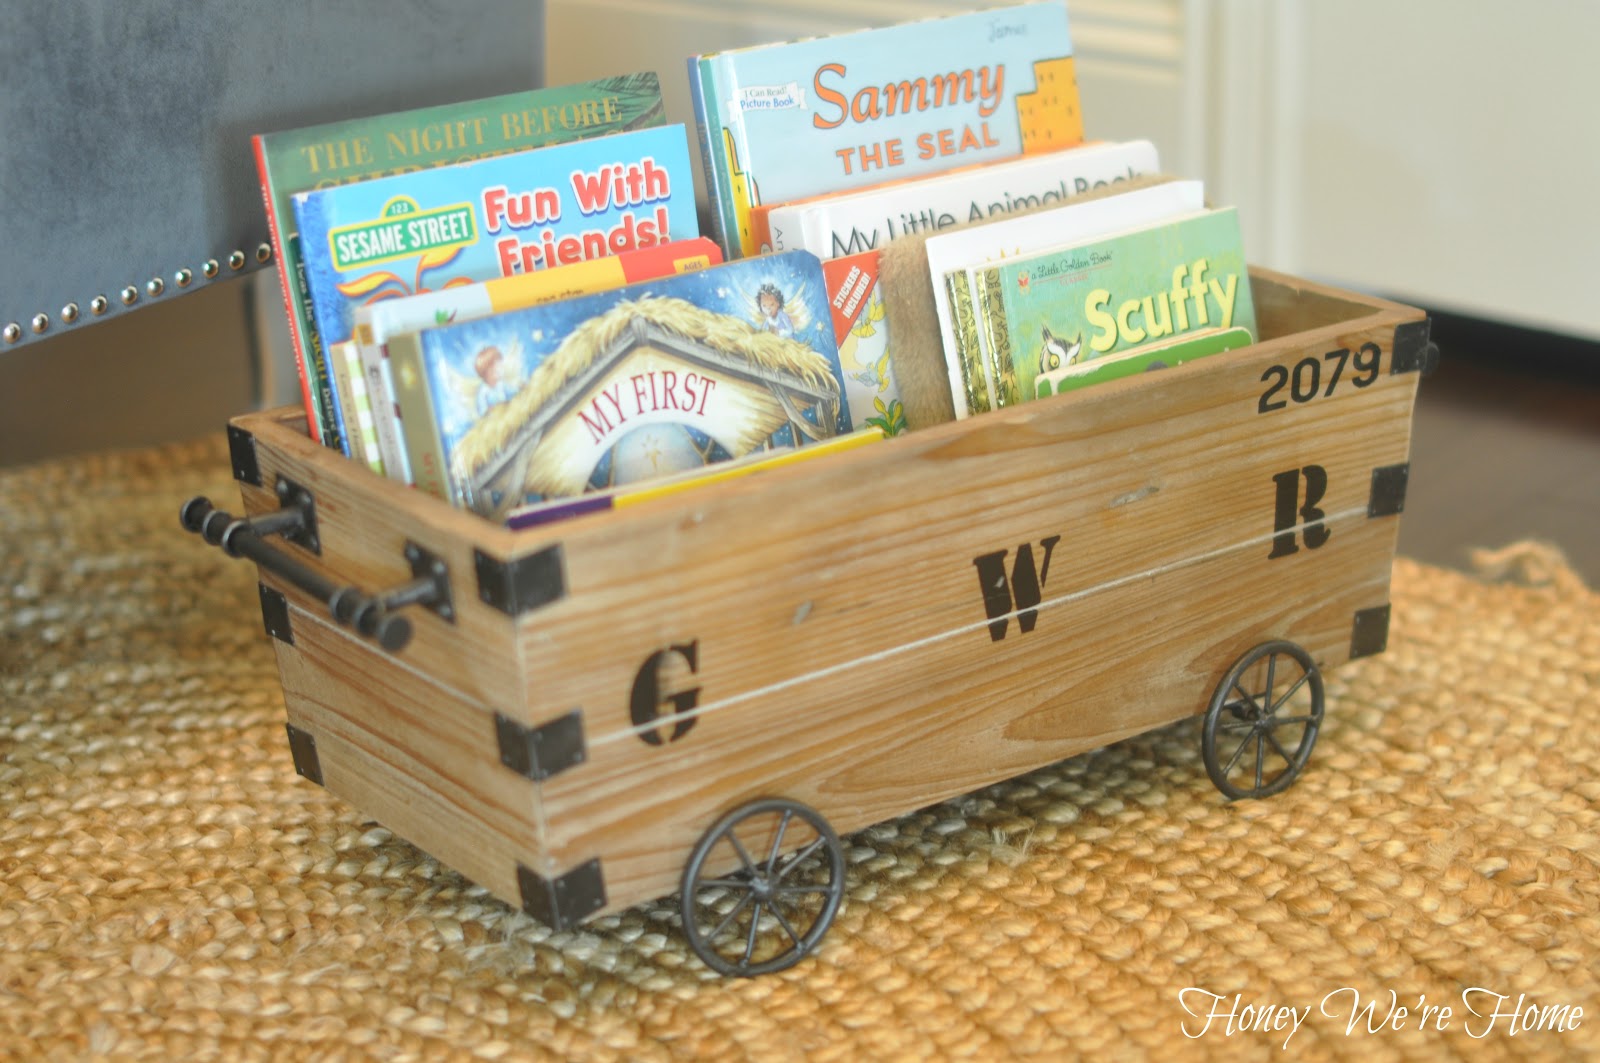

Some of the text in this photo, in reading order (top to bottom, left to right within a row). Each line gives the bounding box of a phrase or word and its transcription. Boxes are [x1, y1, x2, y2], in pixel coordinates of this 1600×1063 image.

[740, 94, 795, 110] Picture Book
[750, 88, 765, 97] Can
[813, 63, 1005, 129] Sammy
[302, 140, 374, 174] THE
[387, 117, 488, 160] NIGHT
[502, 95, 623, 140] BEFORE
[836, 123, 1000, 175] THE SEAL
[391, 204, 409, 214] 123
[484, 188, 560, 230] Fun
[572, 160, 670, 212] With
[831, 226, 878, 258] My
[886, 206, 956, 242] Little
[967, 181, 1067, 224] Animal
[337, 211, 468, 262] SESAME STREET
[498, 208, 670, 277] Friends!
[1060, 259, 1090, 273] Golden
[683, 262, 702, 271] AGES
[833, 265, 861, 309] STICKERS
[842, 272, 871, 319] INCLUDED!
[1085, 259, 1238, 352] Scuffy
[1258, 342, 1381, 414] 2079
[578, 371, 716, 446] MY FIRST
[629, 465, 1331, 746] G W R
